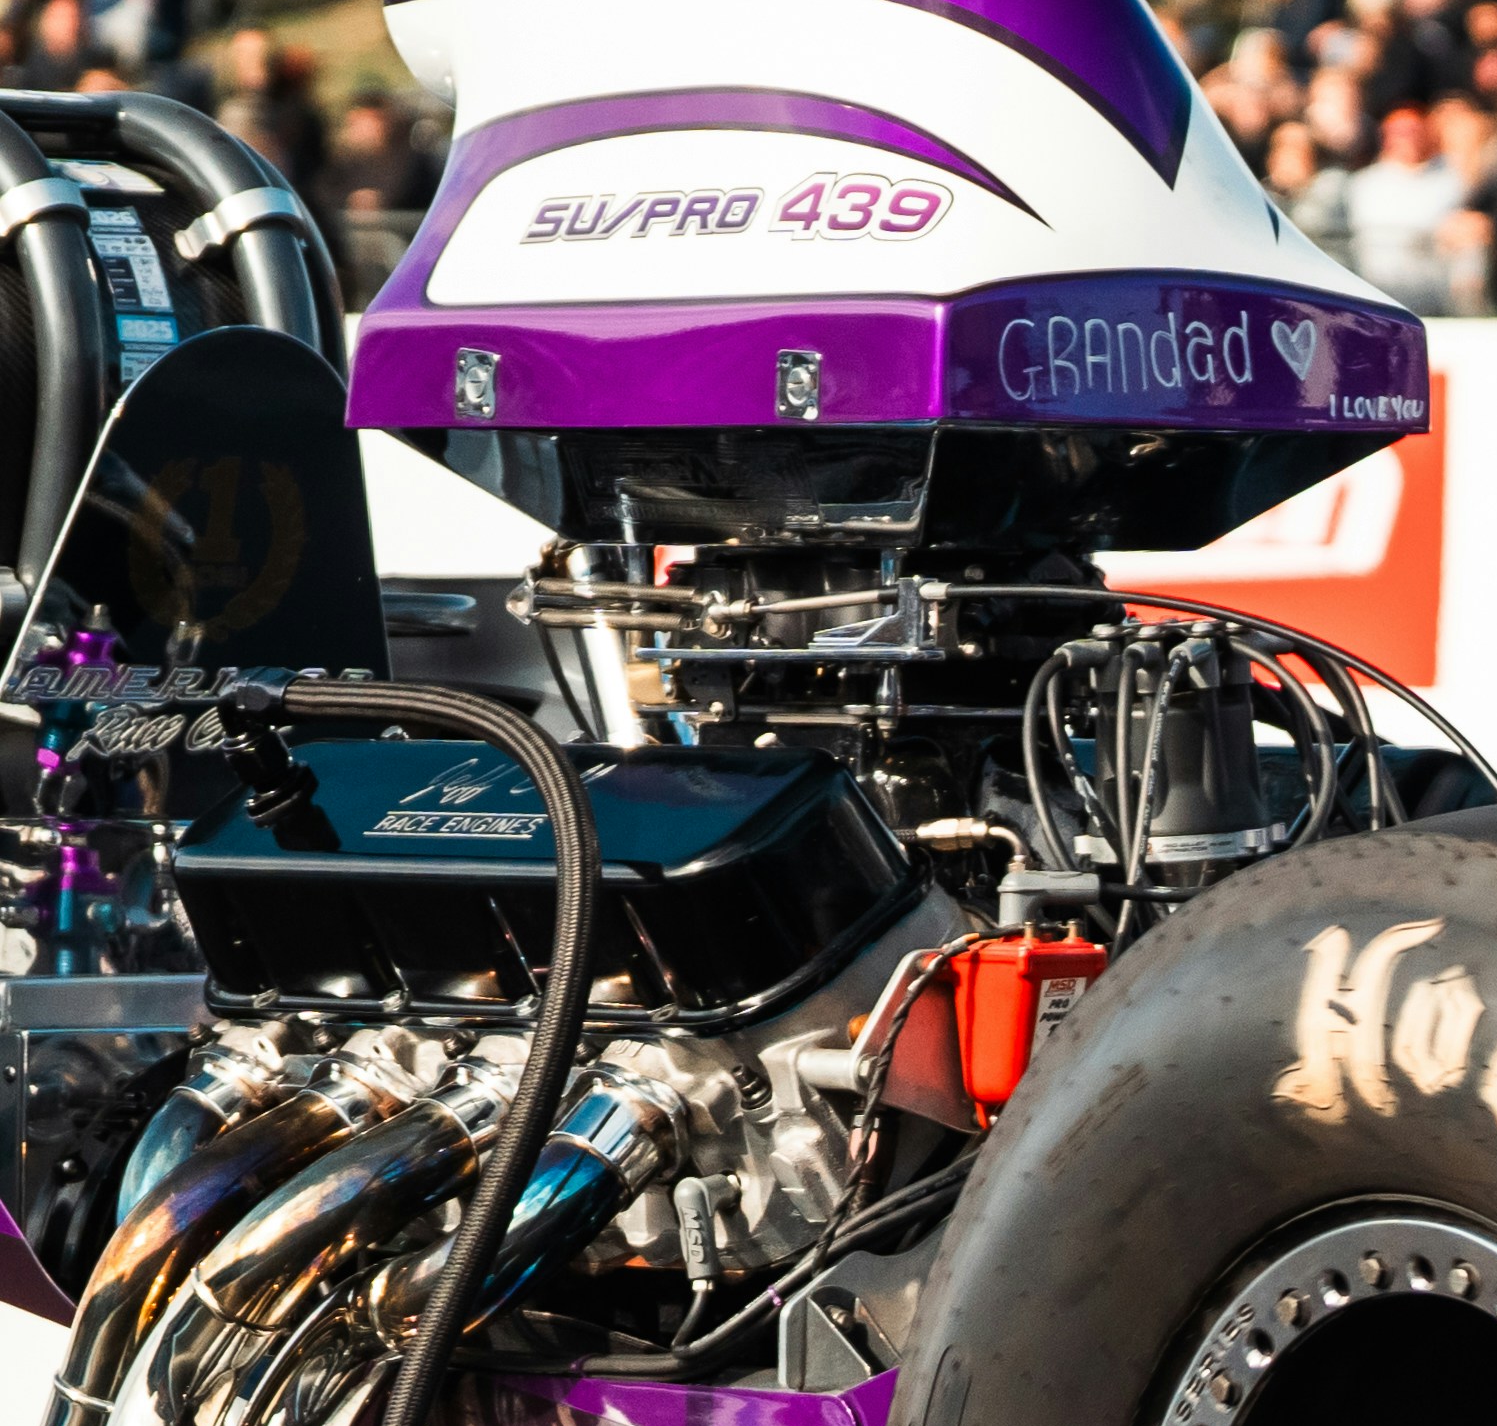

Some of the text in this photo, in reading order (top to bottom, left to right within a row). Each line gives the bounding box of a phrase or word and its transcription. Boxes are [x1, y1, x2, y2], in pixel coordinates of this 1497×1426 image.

[768, 173, 953, 241] 439
[1329, 393, 1337, 418] I
[1343, 395, 1390, 421] LOVE
[12, 663, 376, 703] AMERI
[373, 815, 544, 835] RACE ENGINES
[680, 1206, 705, 1264] MSD
